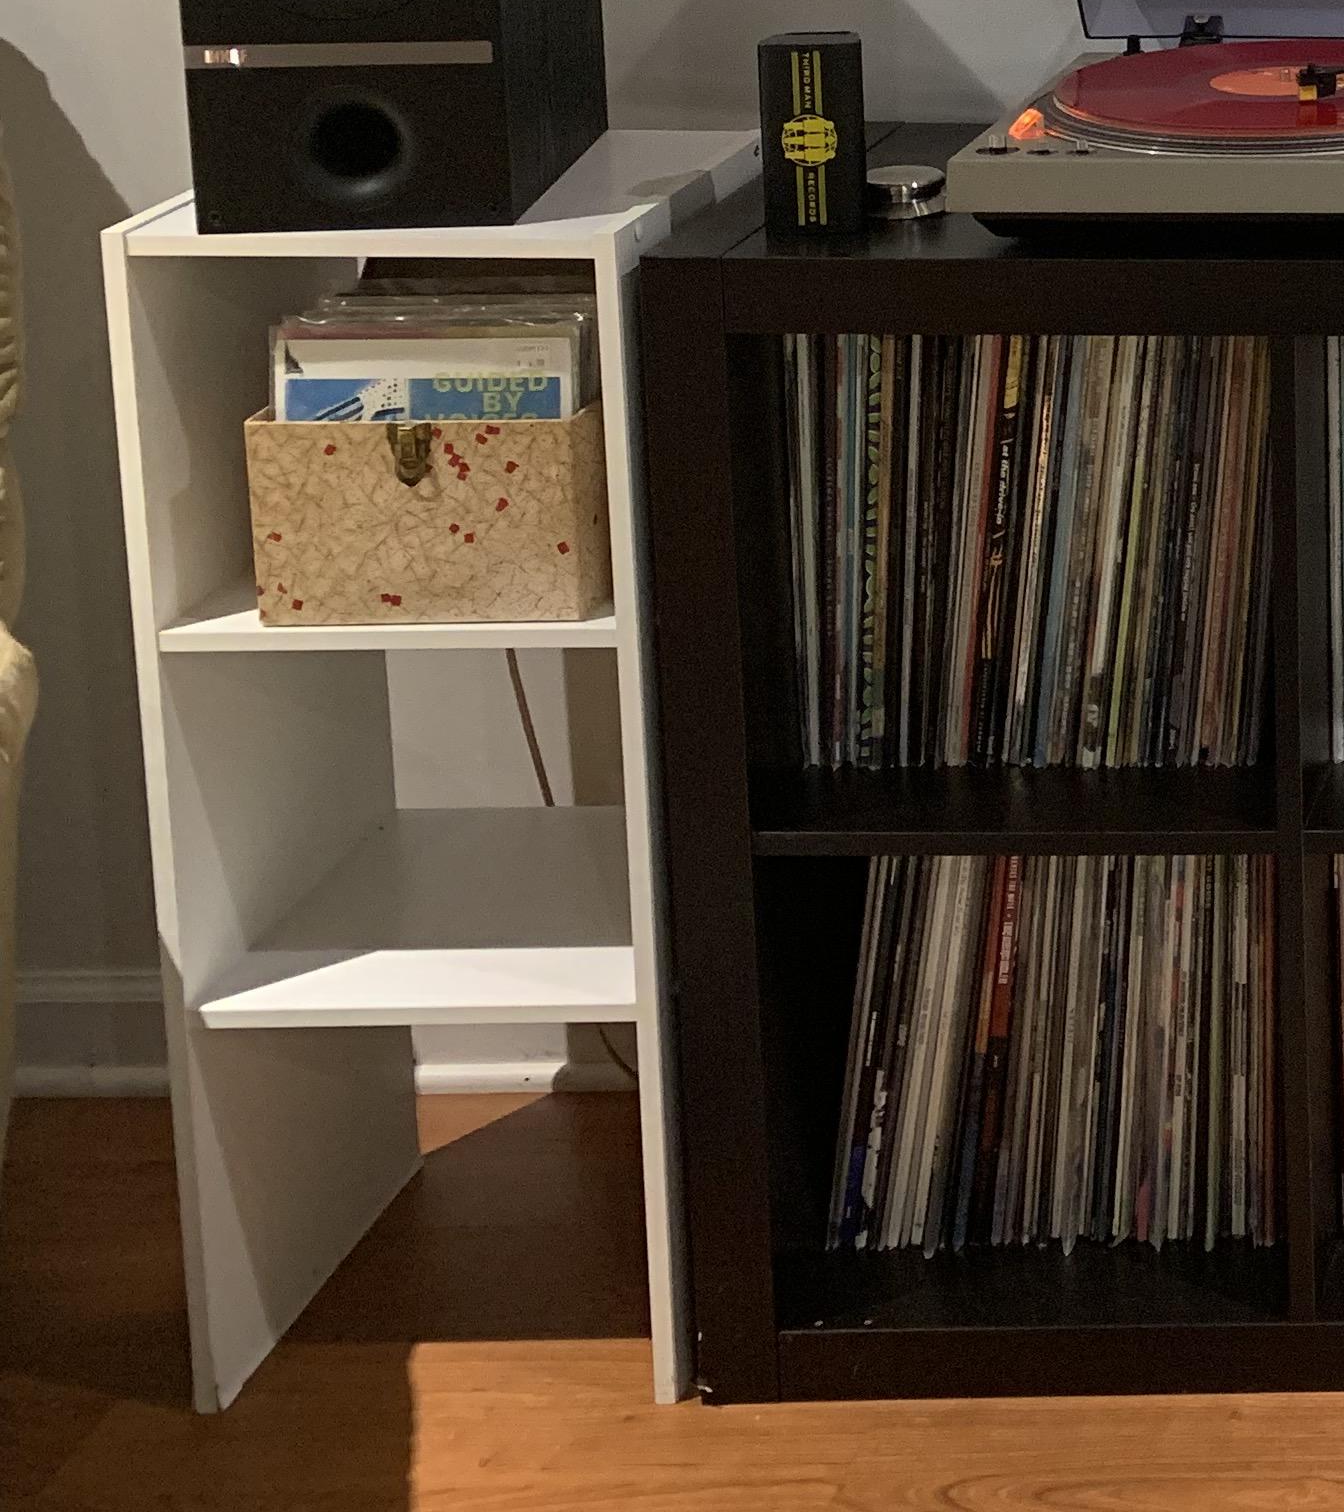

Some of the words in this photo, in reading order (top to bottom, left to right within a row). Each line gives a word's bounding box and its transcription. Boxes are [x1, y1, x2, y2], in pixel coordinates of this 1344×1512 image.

[802, 52, 811, 85] THIRD
[803, 85, 812, 109] MAN
[807, 172, 817, 223] RECORDS
[432, 371, 548, 393] GUIDED
[483, 391, 523, 413] BY
[1002, 444, 1010, 457] at
[1000, 459, 1010, 478] the
[996, 480, 1007, 525] drive-in
